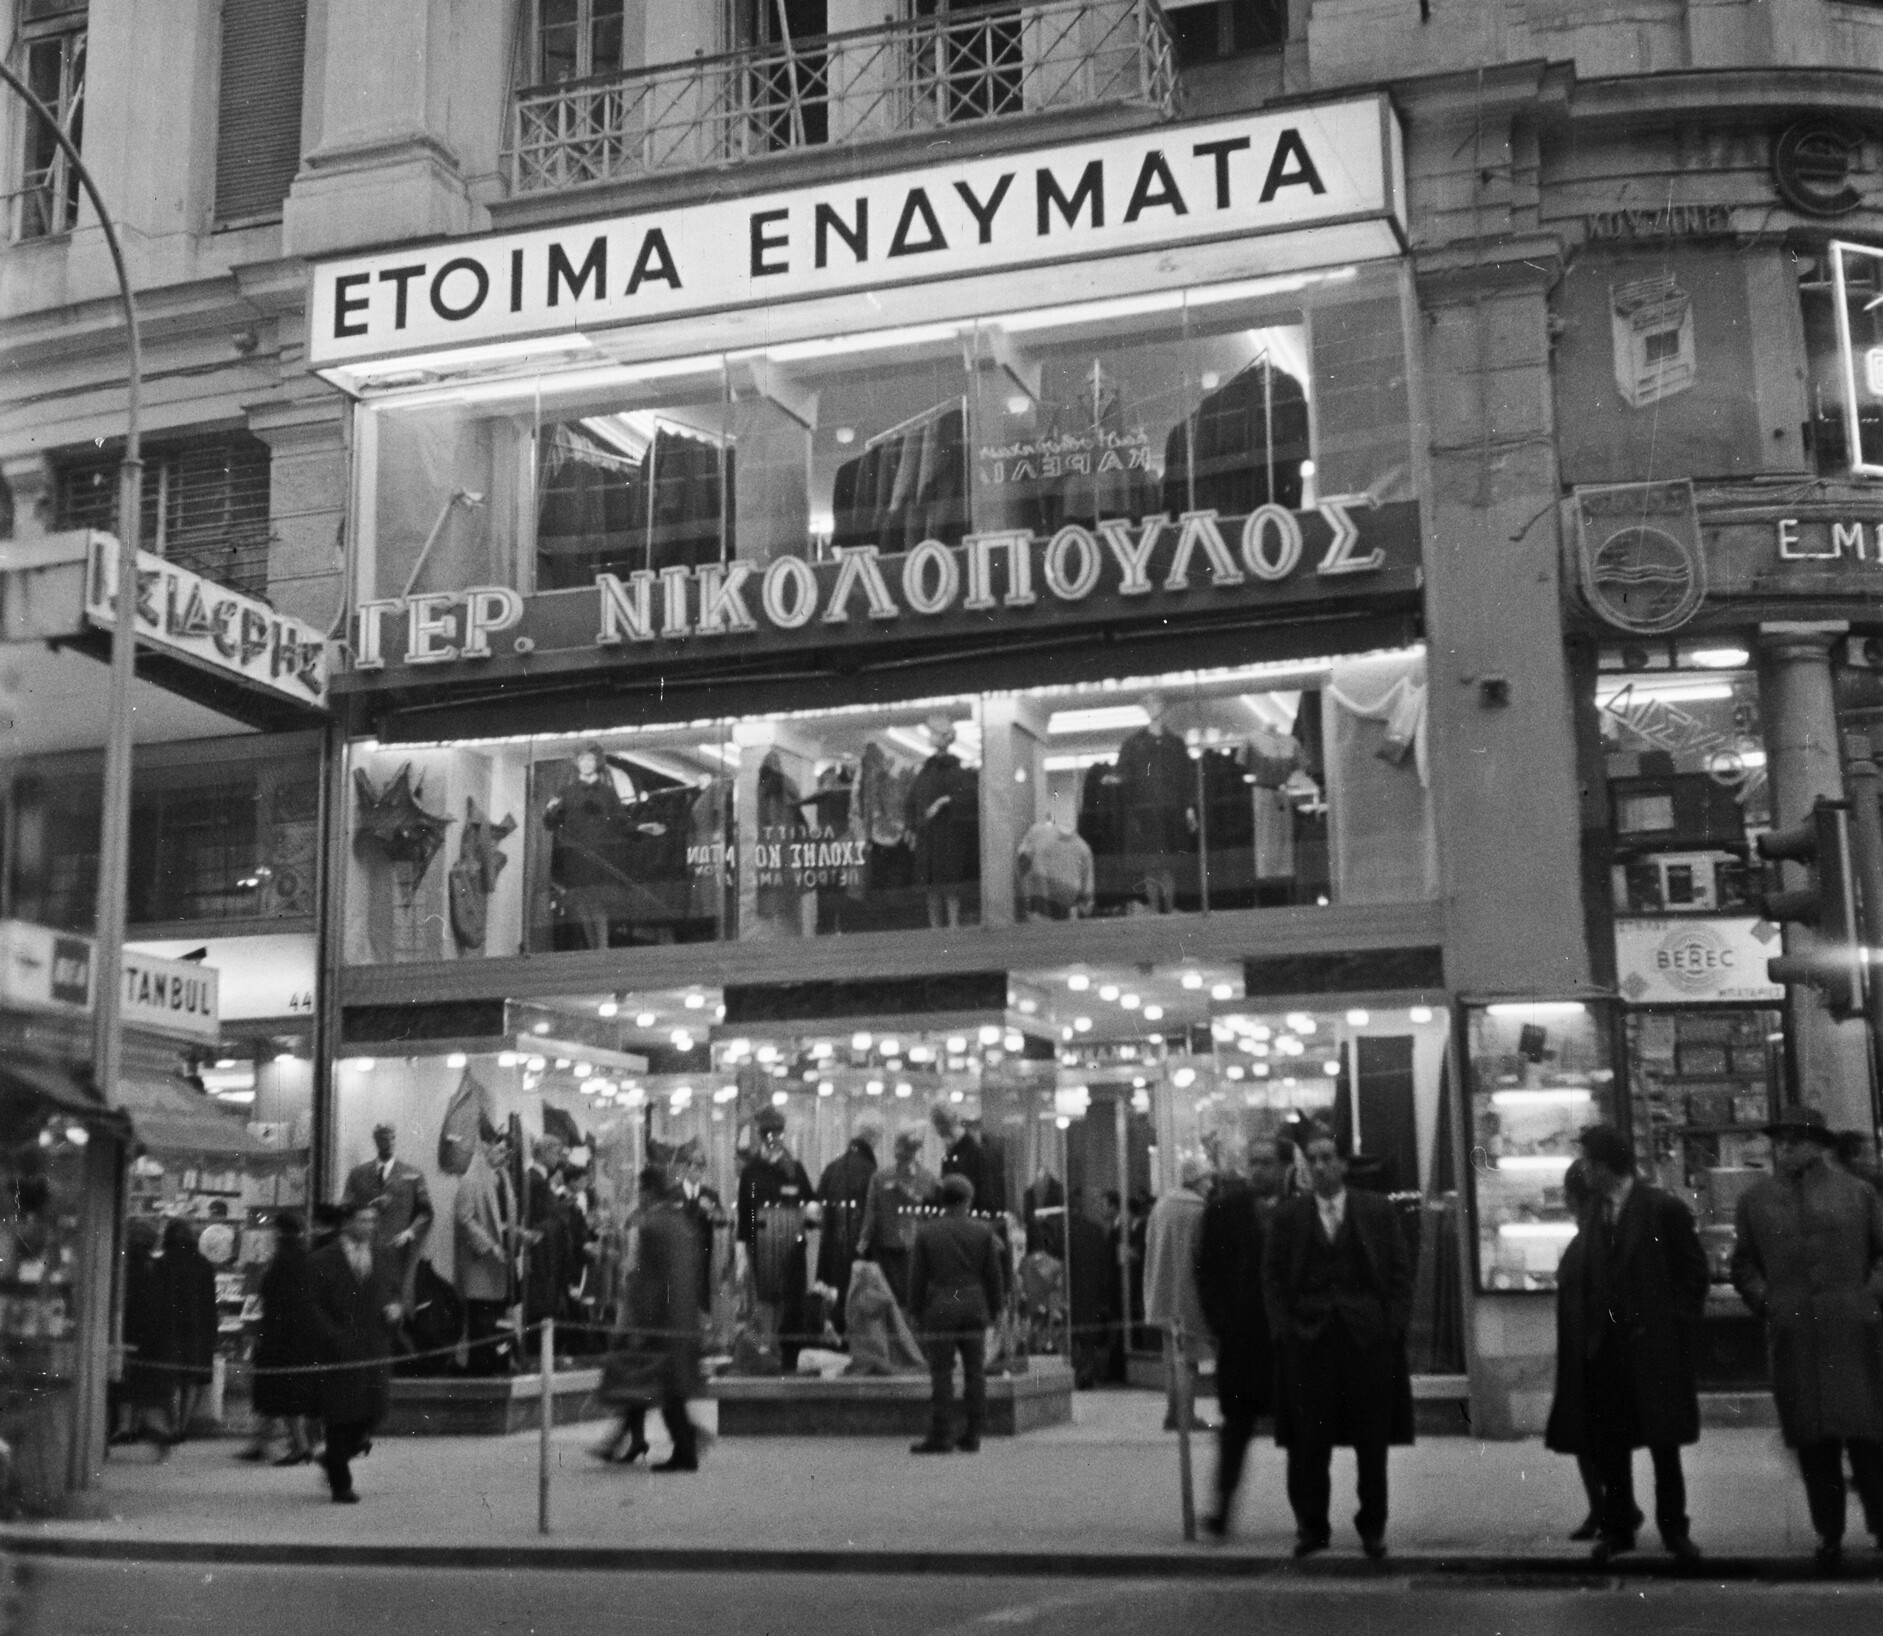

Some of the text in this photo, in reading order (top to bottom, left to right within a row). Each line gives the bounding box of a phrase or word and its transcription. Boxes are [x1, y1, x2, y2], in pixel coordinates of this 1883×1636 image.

[334, 128, 1328, 339] ΕΤΟΙΜΑ ΕΝΔΥΜΑΤΑ
[354, 492, 1387, 669] ΓΕΡ. ΝΙΚΟΛΟΠΟΥΛΟΣ
[1657, 950, 1734, 969] BEREC
